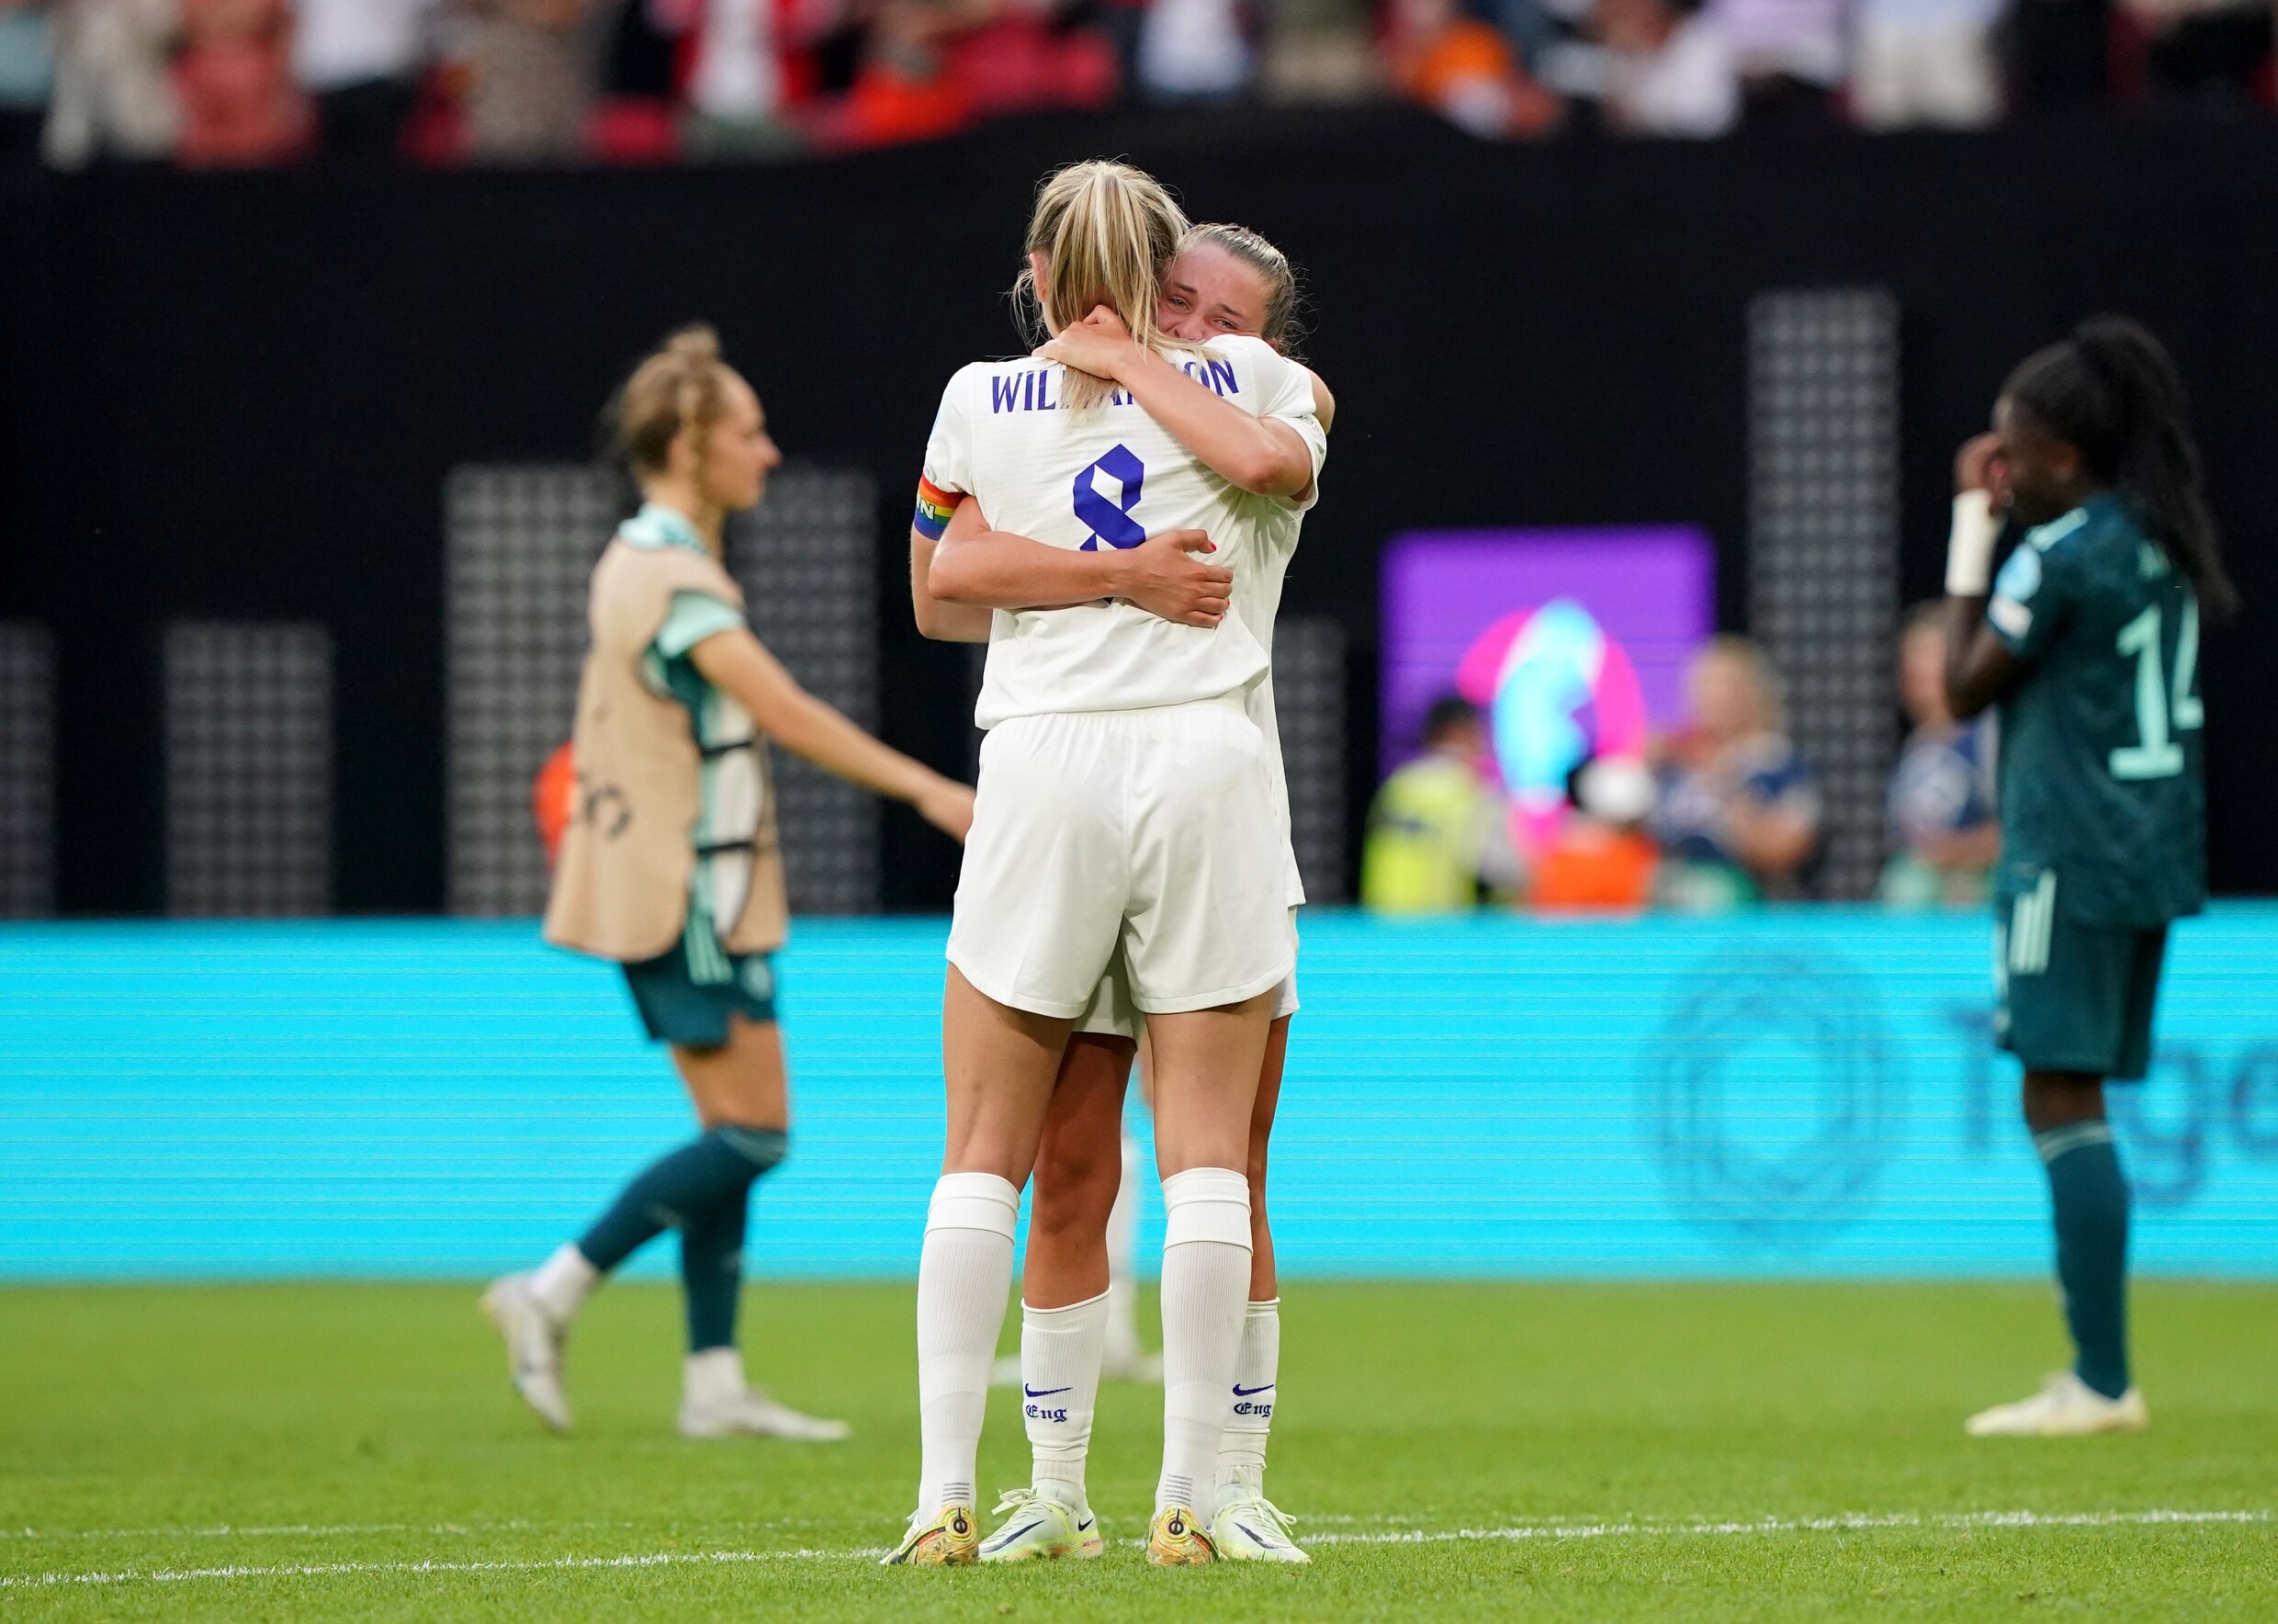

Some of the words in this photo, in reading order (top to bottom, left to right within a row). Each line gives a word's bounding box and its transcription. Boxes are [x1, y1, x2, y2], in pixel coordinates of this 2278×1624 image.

[1073, 443, 1145, 551] 8
[1025, 1404, 1067, 1423] Eng
[1234, 1402, 1271, 1417] Eng
